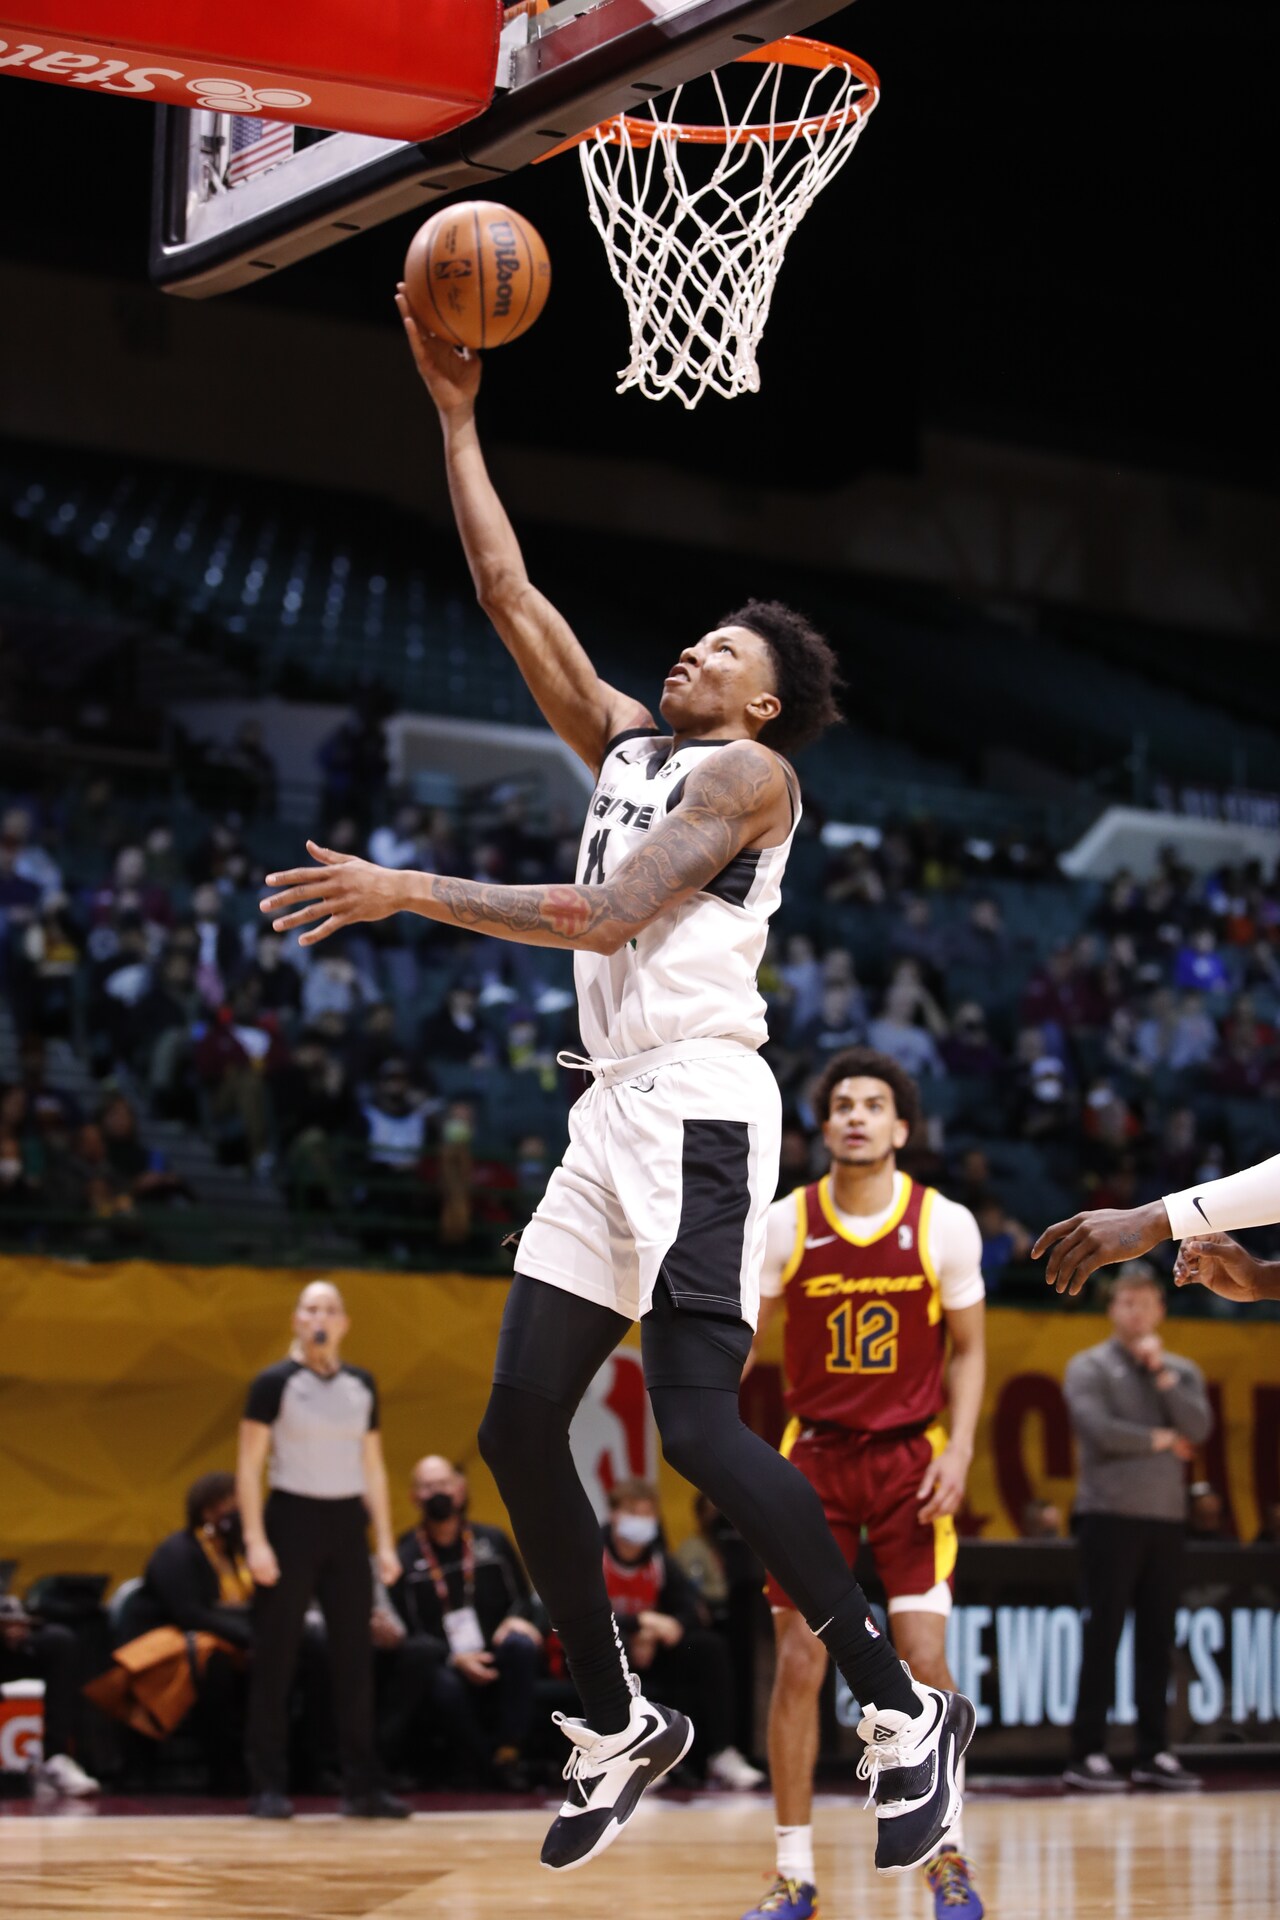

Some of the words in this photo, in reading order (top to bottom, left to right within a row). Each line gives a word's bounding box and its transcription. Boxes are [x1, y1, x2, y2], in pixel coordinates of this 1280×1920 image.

[0, 39, 185, 93] Stat
[488, 221, 520, 317] Wilson
[826, 1299, 899, 1374] 12
